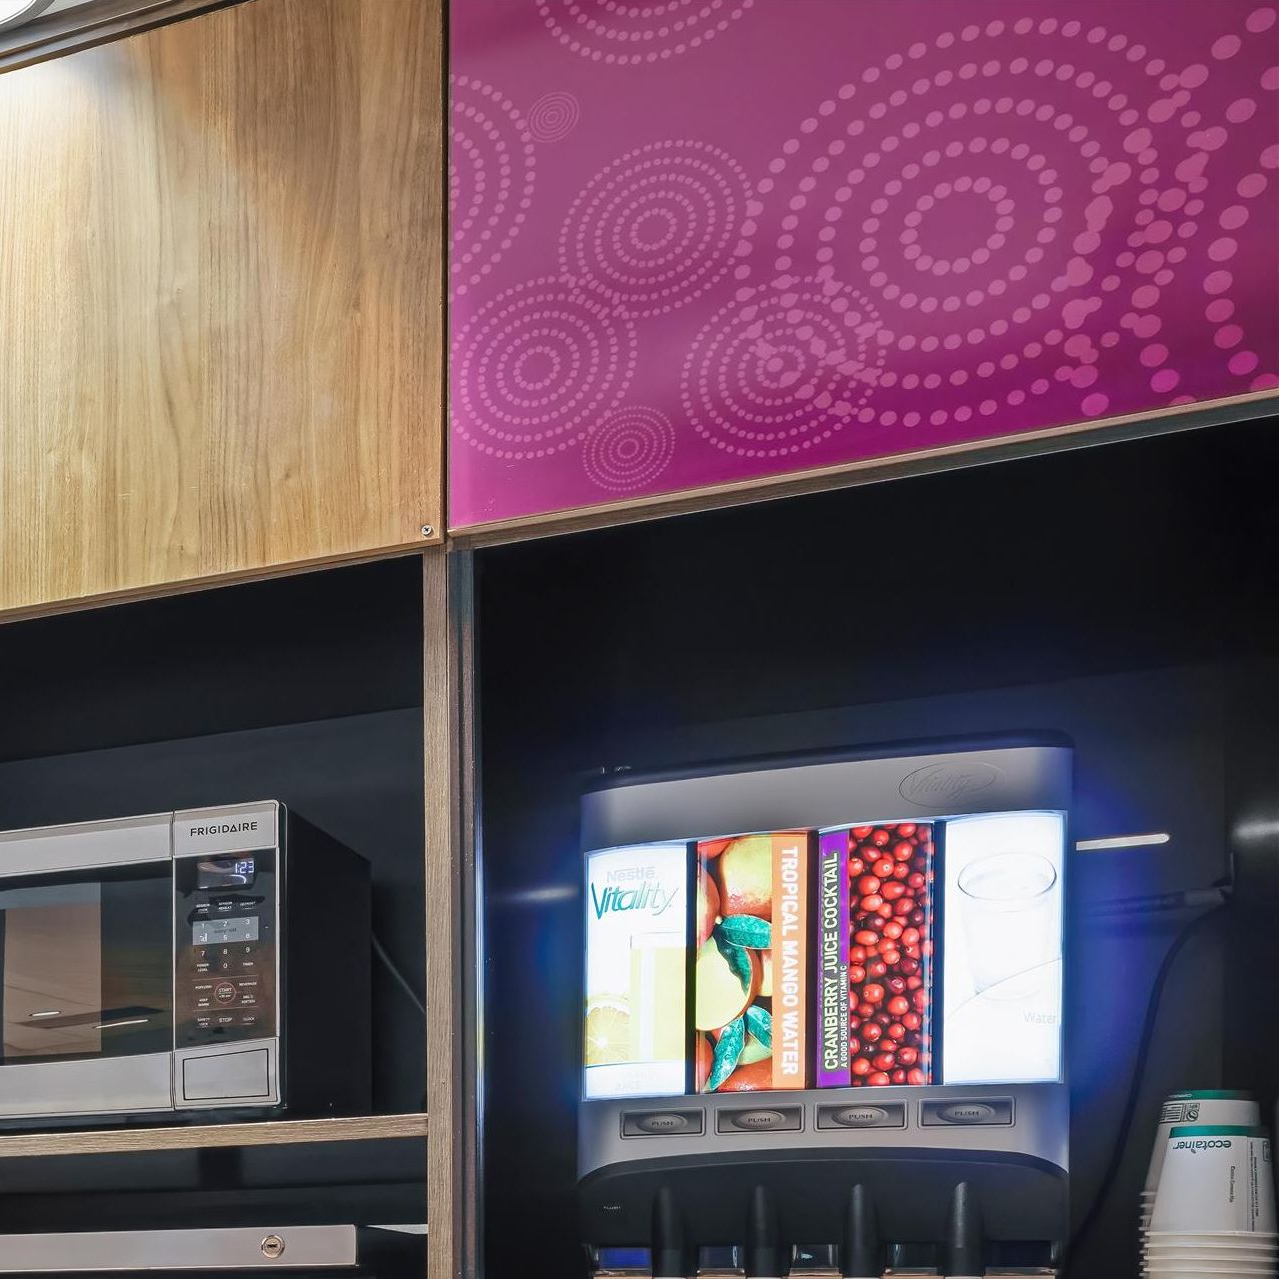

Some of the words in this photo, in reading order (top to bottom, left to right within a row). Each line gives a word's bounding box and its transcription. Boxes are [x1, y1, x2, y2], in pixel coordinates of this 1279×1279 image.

[190, 821, 258, 837] FRIGIDAIRE
[235, 860, 254, 874] 1:23
[591, 881, 679, 920] Vitality
[781, 846, 798, 936] TROPICAL
[824, 852, 838, 929] COCKTAIL
[824, 932, 838, 973] JUICE
[781, 941, 798, 1007] MANGO
[824, 978, 838, 1070] CRANBERRY
[841, 1002, 848, 1010] OF
[1022, 1010, 1056, 1024] Water
[781, 1012, 798, 1075] WATER
[953, 1109, 979, 1117] PUSH
[1173, 1140, 1232, 1152] ecotainer
